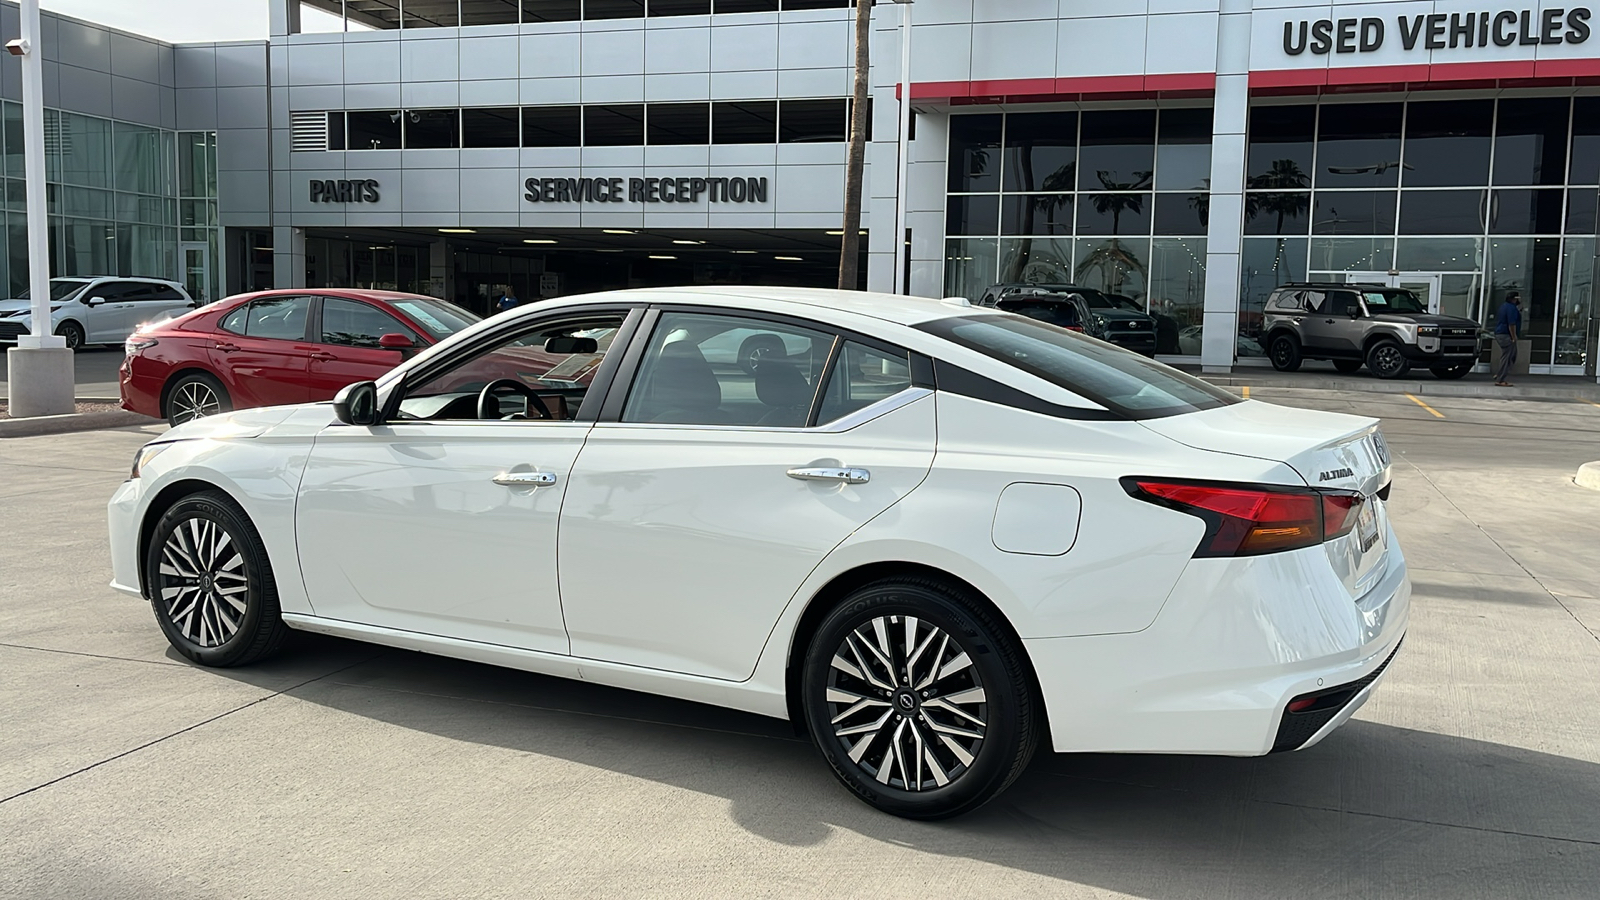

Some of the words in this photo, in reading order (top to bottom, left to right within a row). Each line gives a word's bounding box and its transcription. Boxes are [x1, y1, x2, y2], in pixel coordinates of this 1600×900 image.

[1283, 17, 1384, 55] USED
[1398, 7, 1592, 50] VEHICLES
[309, 179, 380, 203] PARTS
[525, 177, 623, 203] SERVICE
[628, 177, 768, 203] RECEPTION
[1319, 467, 1354, 482] ALTIMA
[195, 503, 230, 523] SOLUS
[844, 595, 899, 617] SOLUS
